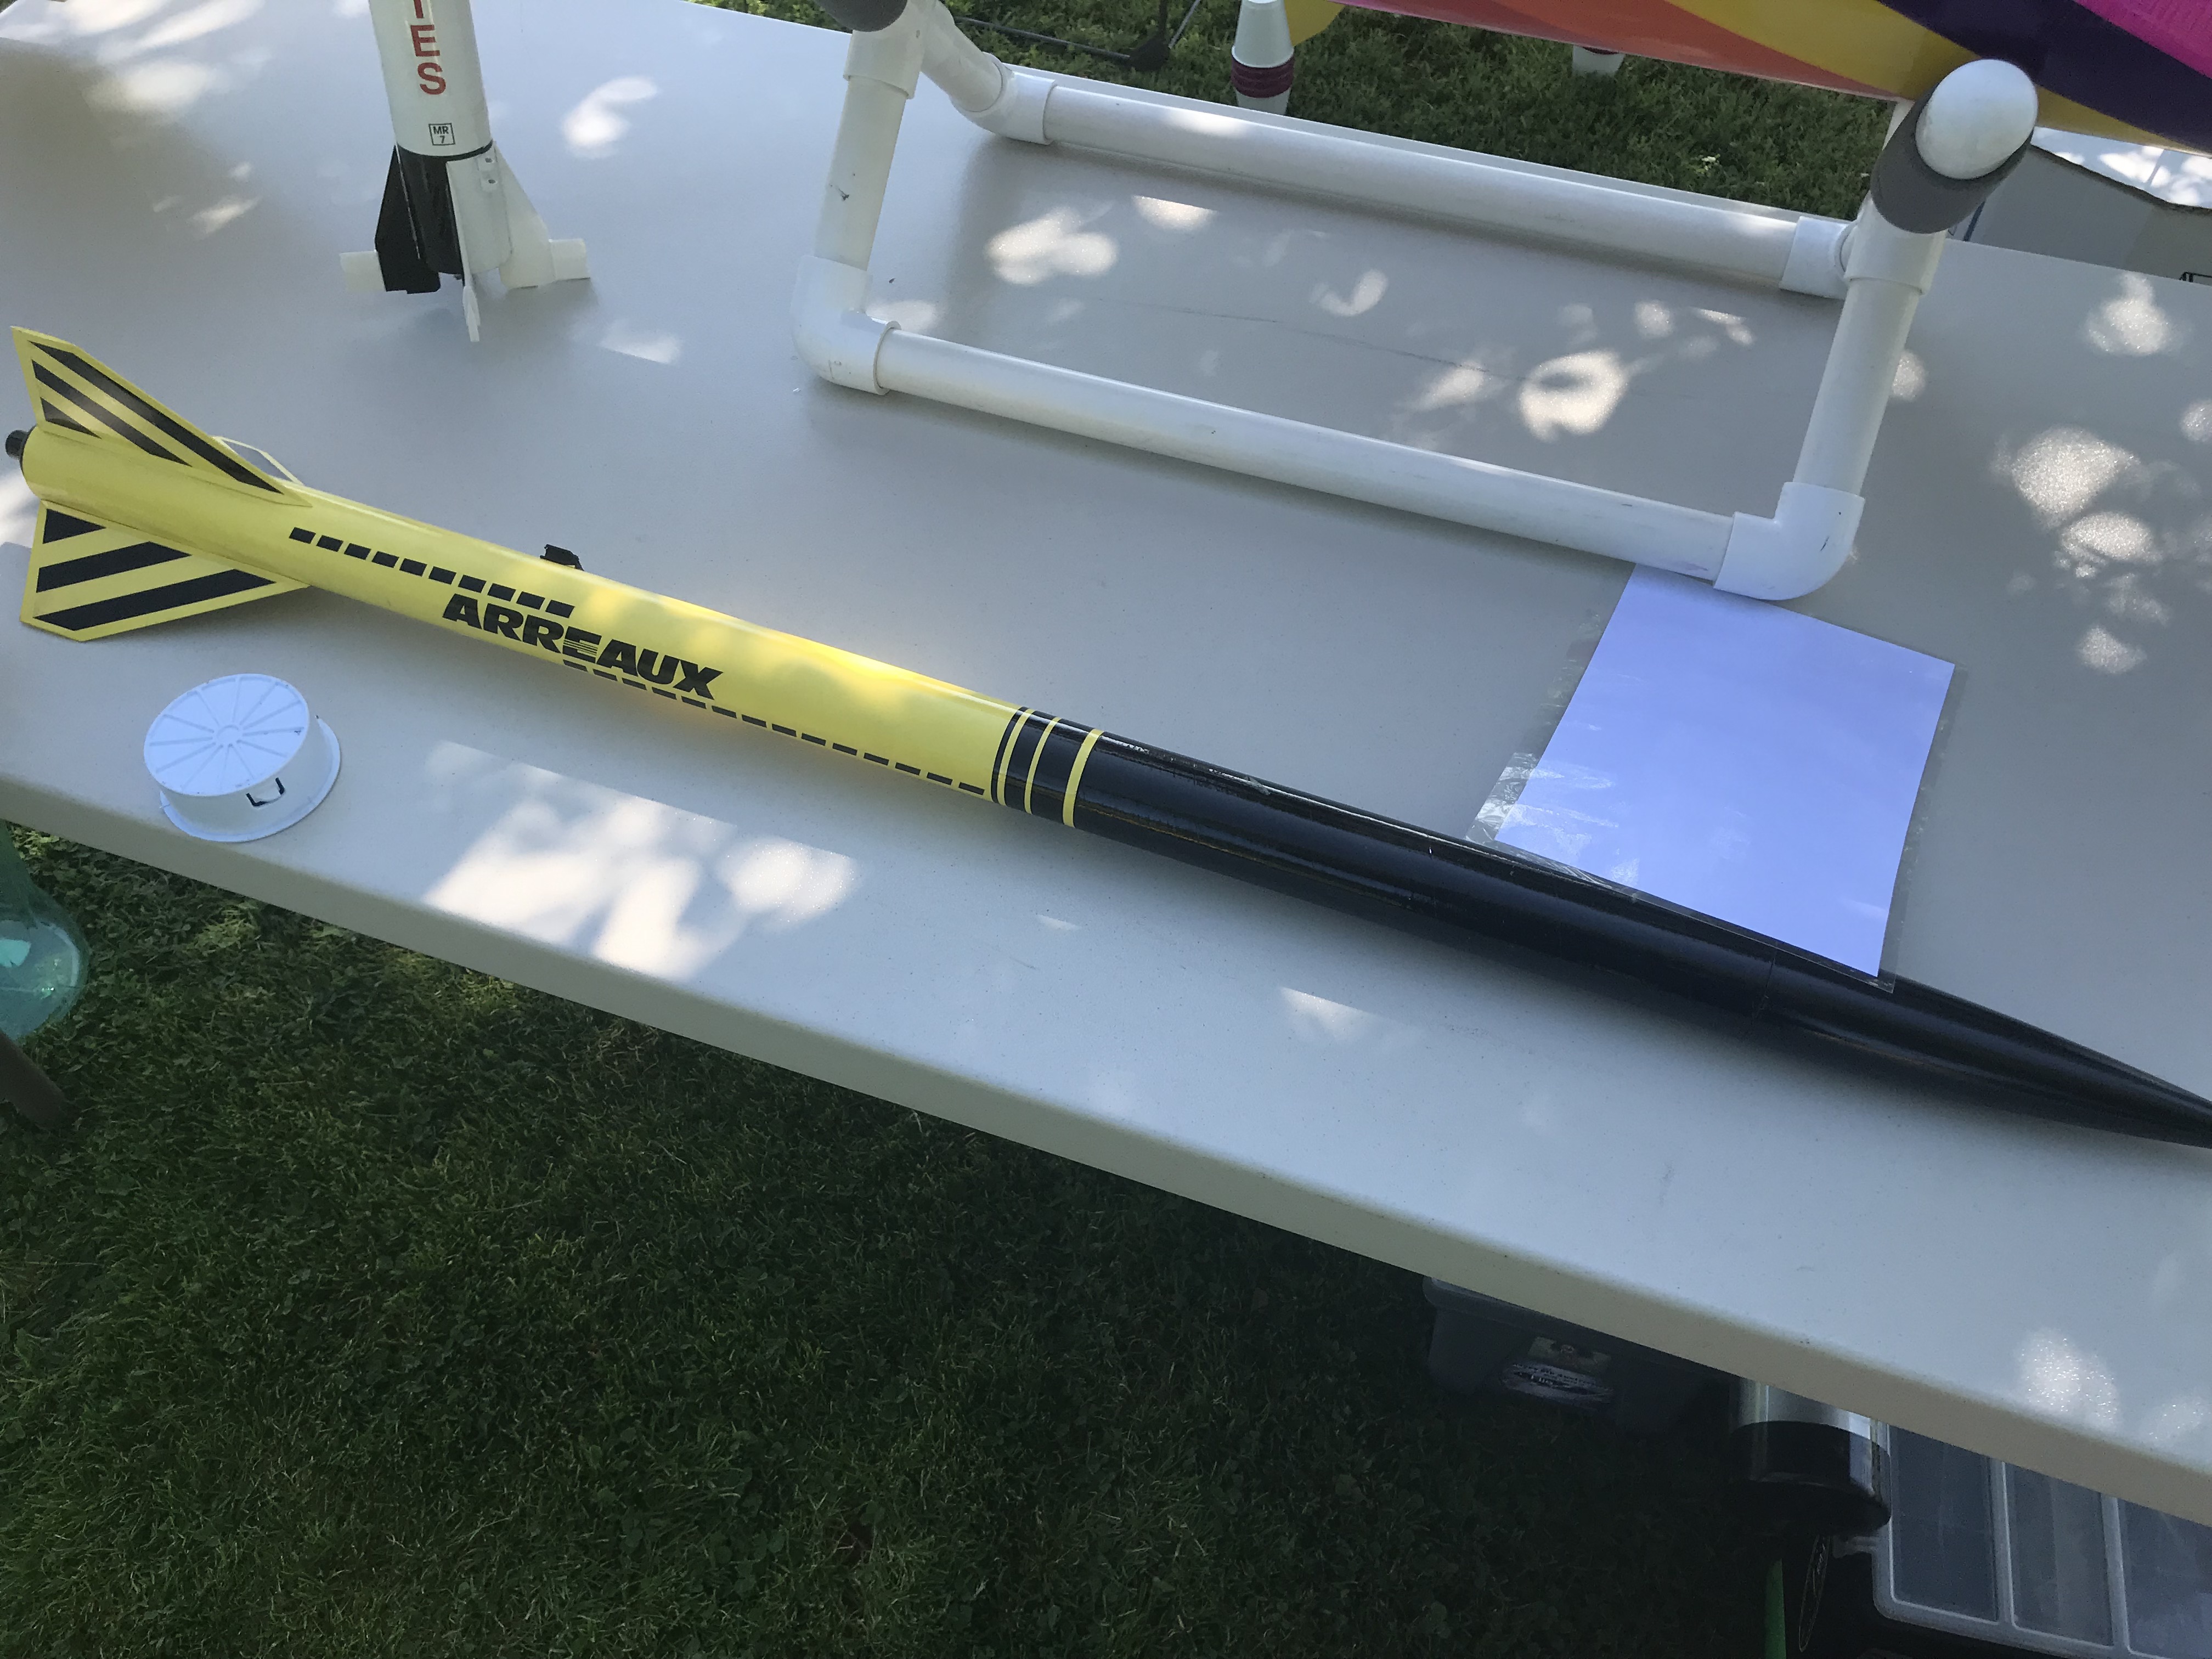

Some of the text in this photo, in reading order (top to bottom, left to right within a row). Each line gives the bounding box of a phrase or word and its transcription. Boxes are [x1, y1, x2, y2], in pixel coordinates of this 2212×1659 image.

[432, 126, 449, 134] MR
[439, 136, 445, 144] 7
[442, 593, 723, 700] ARREAUX
